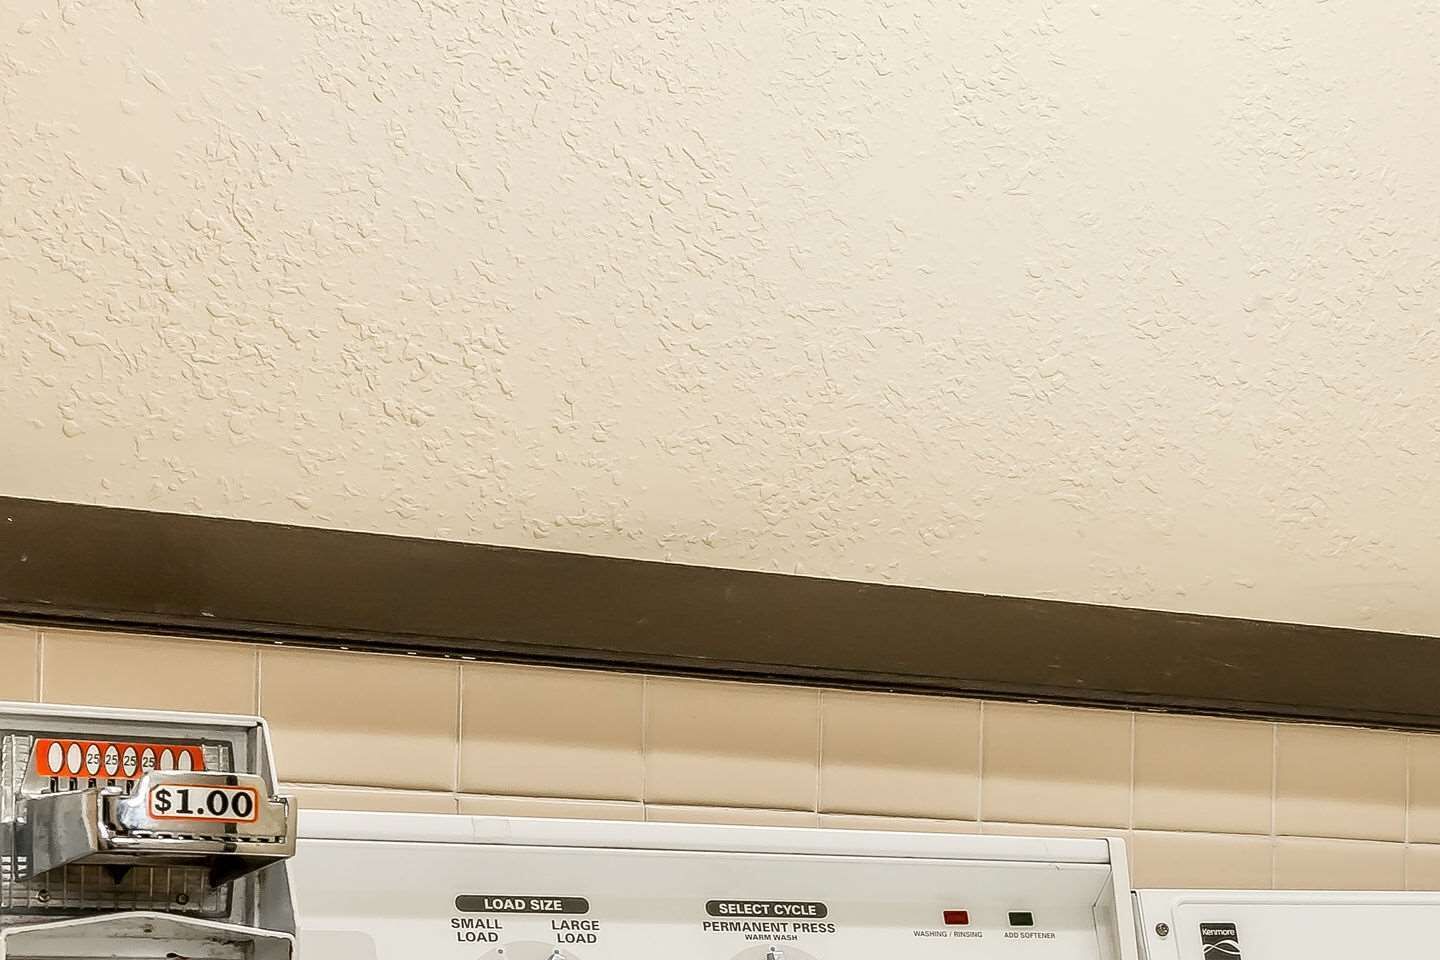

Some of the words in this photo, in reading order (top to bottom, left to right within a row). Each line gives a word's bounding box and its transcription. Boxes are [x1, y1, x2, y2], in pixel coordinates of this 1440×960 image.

[87, 753, 100, 765] 25
[105, 754, 118, 766] 25
[124, 755, 136, 767] 25
[143, 756, 155, 768] 25
[154, 788, 252, 818] $1.00
[484, 898, 525, 911] LOAD
[530, 899, 562, 911] SIZE
[719, 903, 769, 915] SELECT
[774, 904, 816, 916] CYCLE
[450, 917, 503, 930] SMALL
[551, 919, 601, 931] LARGE
[702, 921, 789, 933] PERMANENT
[791, 922, 836, 934] PRESS
[456, 931, 499, 943] LOAD
[744, 933, 772, 941] WARM
[912, 930, 948, 938] WASHING
[953, 930, 983, 938] RINSING
[1003, 931, 1020, 939] ADD
[1020, 931, 1056, 939] SOFTENER
[1201, 927, 1235, 936] Kenmore
[556, 932, 597, 944] LOAD
